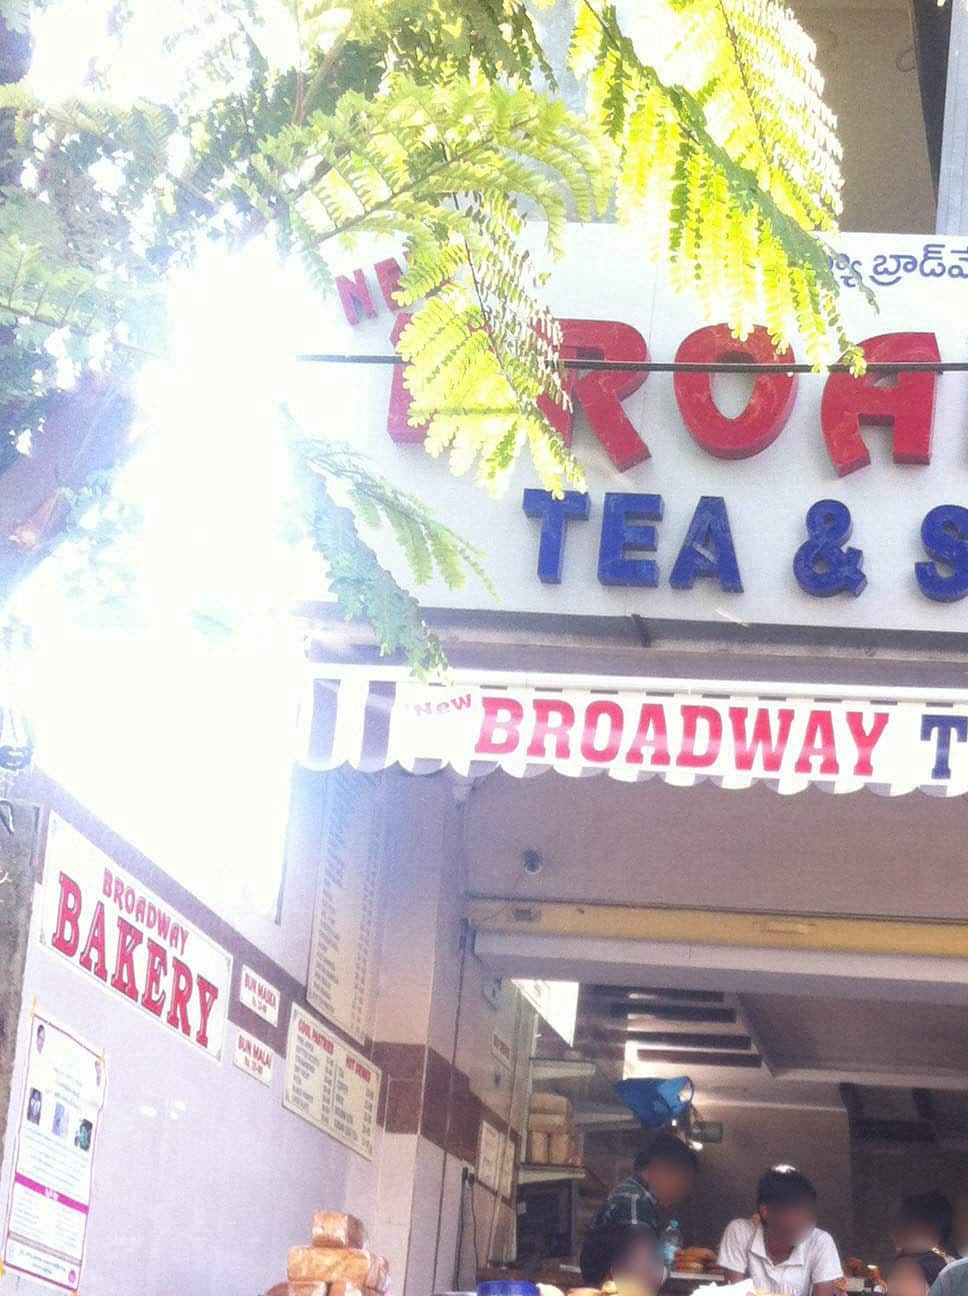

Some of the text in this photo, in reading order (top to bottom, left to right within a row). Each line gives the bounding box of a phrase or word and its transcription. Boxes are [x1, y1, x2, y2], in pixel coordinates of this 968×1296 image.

[523, 488, 743, 594] TEA
[793, 499, 867, 598] &
[474, 697, 889, 777] BROADWAY
[52, 871, 219, 1049] BAKERY
[102, 868, 189, 956] BROADWAY
